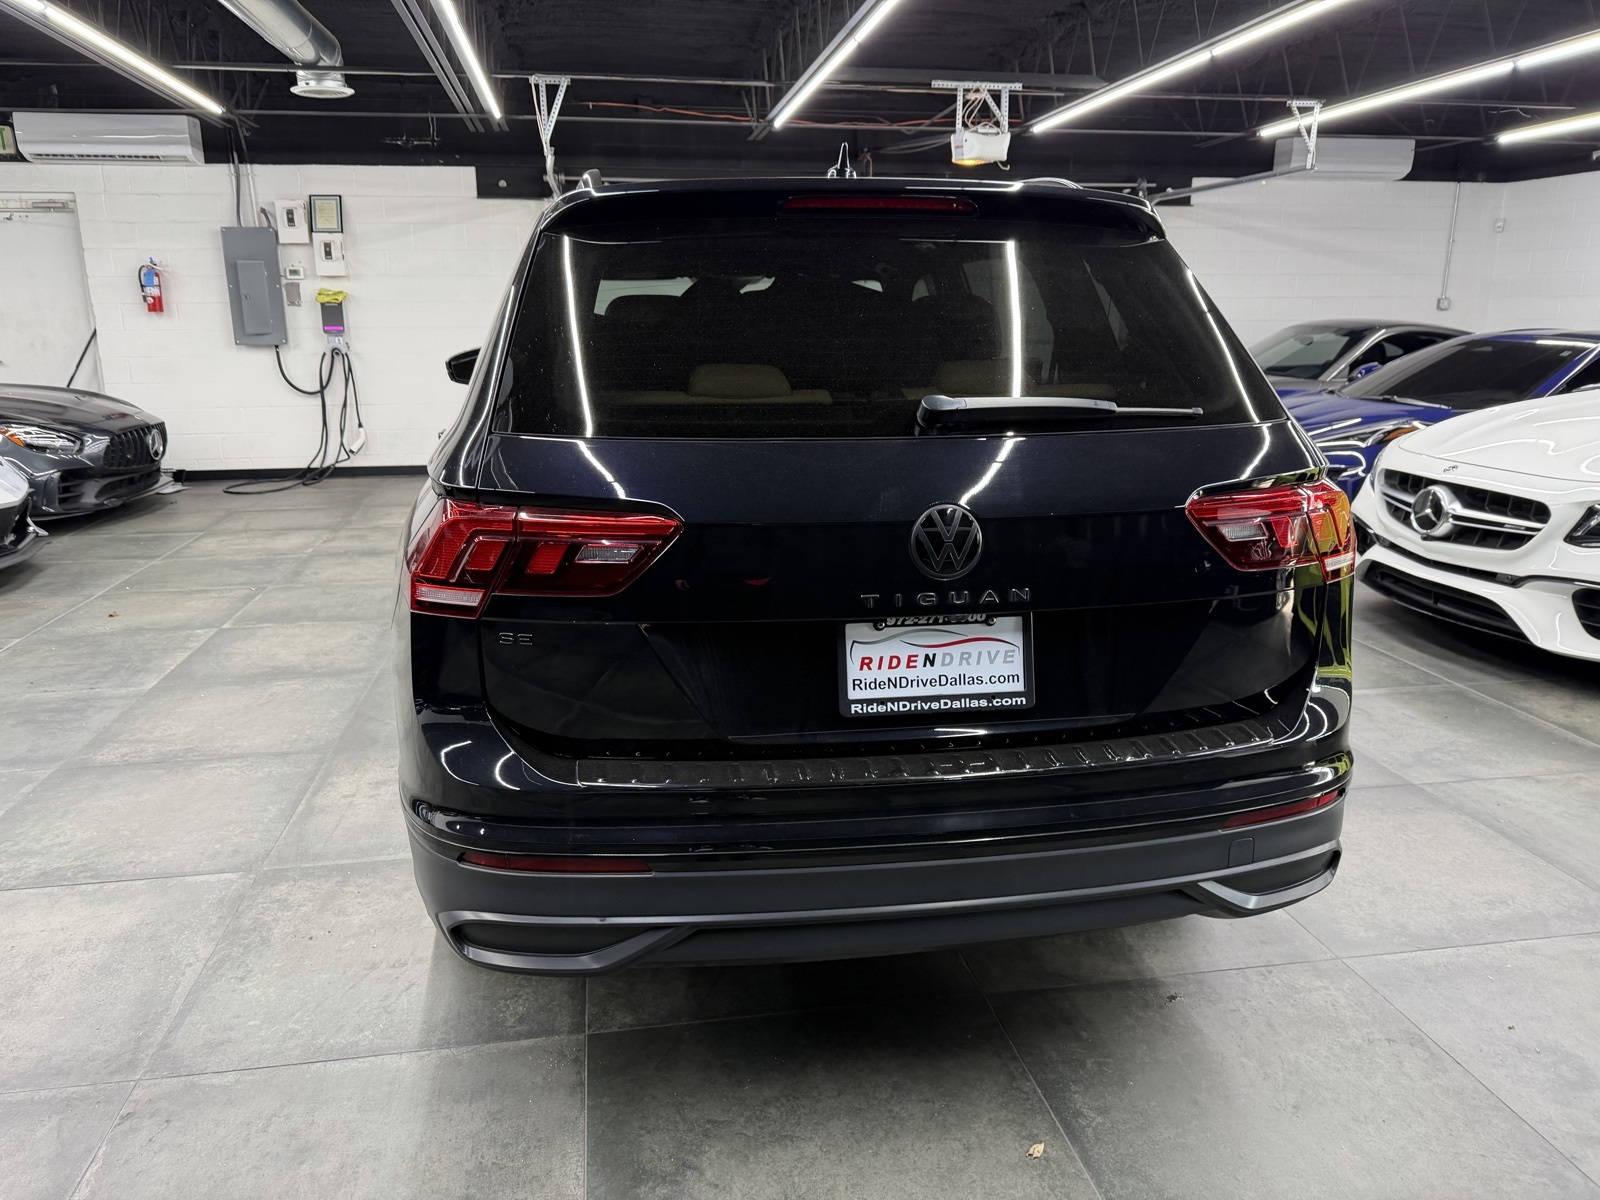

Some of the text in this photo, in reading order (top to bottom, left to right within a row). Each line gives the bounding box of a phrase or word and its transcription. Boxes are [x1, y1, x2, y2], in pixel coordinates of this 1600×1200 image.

[860, 587, 1031, 609] TIGUAN
[499, 632, 533, 645] SE
[852, 672, 1021, 692] RideNDriveDallas.com
[851, 696, 1027, 715] RideNDriveDallas.com
